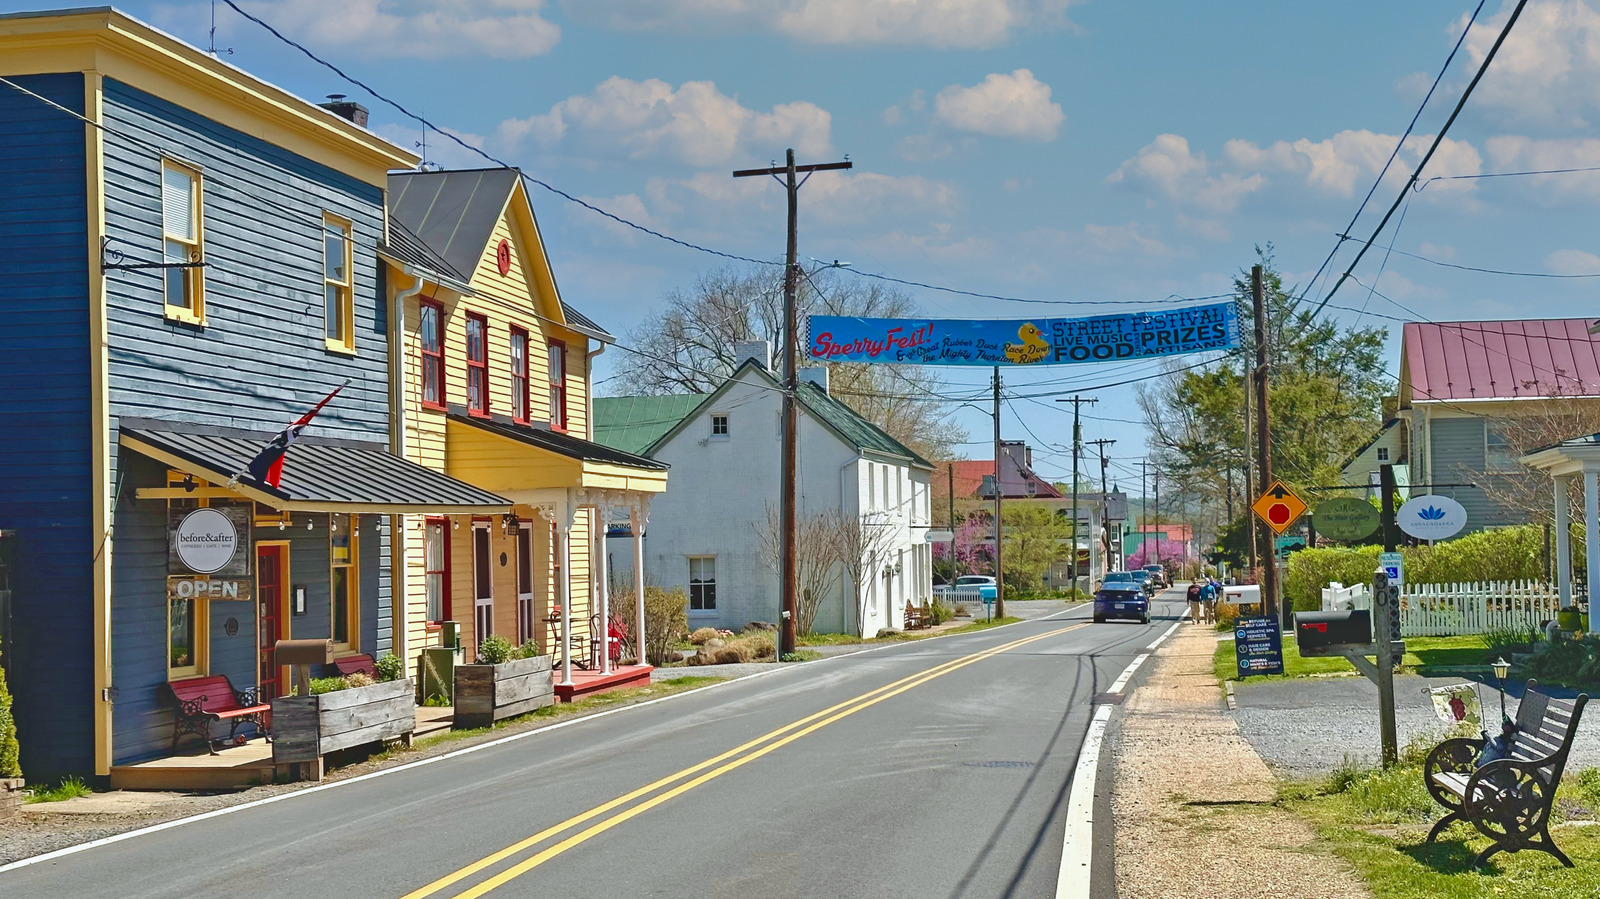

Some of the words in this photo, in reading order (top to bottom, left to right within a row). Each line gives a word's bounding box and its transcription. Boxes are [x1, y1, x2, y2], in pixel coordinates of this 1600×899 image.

[1227, 303, 1236, 316] 29
[1052, 318, 1125, 337] STREET
[1131, 308, 1224, 332] FESTIVAL
[1054, 336, 1083, 346] LIVE
[1087, 332, 1133, 345] MUSIC
[1141, 323, 1226, 346] PRIZES
[1228, 317, 1240, 346] APRIL
[896, 349, 905, 362] &
[917, 342, 939, 356] Great
[942, 337, 973, 348] Rubber
[976, 338, 999, 350] Duck
[1001, 342, 1024, 353] Race
[1028, 344, 1053, 354] Down
[922, 354, 935, 363] the
[939, 348, 971, 359] Mighty
[976, 349, 1014, 363] Thornton
[1018, 354, 1044, 364] River
[1054, 343, 1134, 362] FOOD
[1143, 340, 1226, 355] ARTISANS
[180, 533, 233, 543] before&after
[177, 581, 238, 598] OPEN
